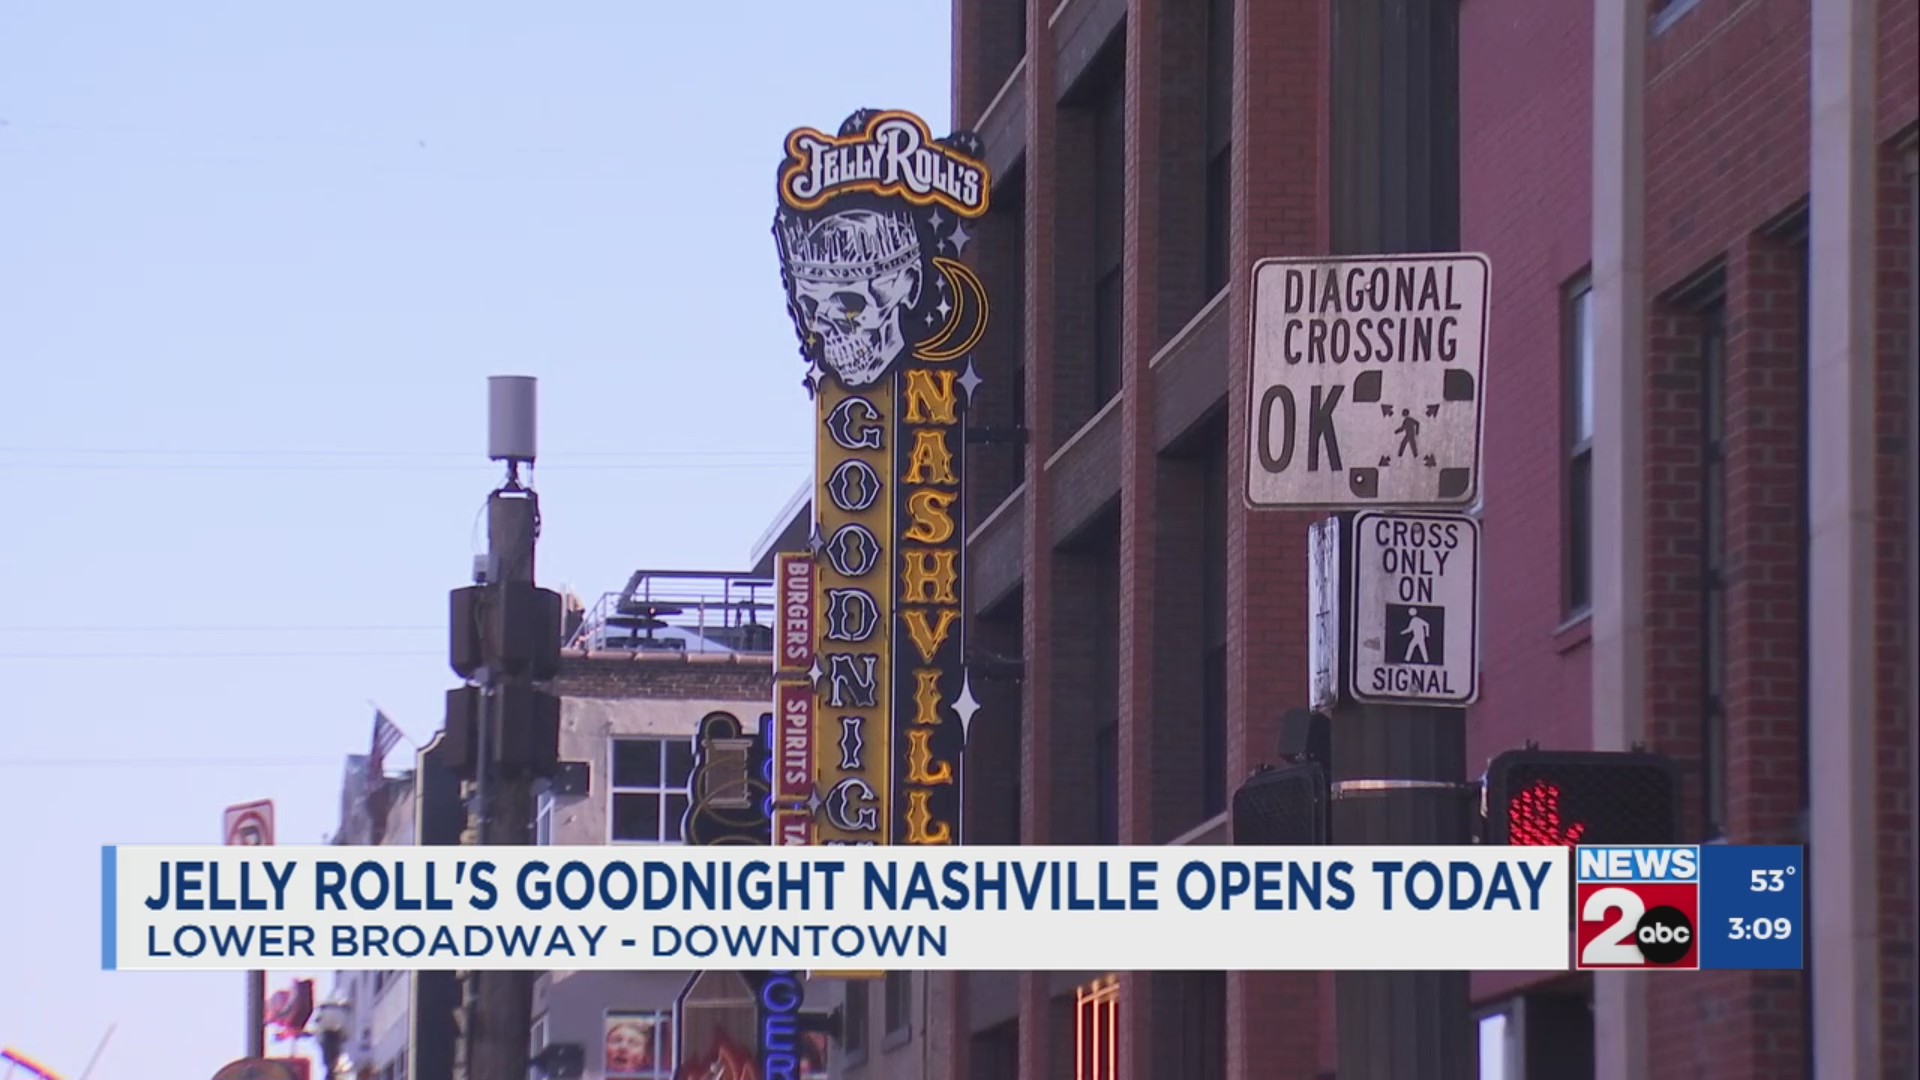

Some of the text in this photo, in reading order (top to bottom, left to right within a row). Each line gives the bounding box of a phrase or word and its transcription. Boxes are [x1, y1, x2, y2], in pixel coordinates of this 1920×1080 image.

[792, 119, 979, 206] JELLY ROLL'S
[1284, 266, 1462, 314] DIAGONAL
[1284, 316, 1458, 365] CROSSING
[1257, 384, 1345, 474] OK
[1375, 519, 1459, 550] CROSS
[1382, 547, 1450, 577] ONLY
[786, 562, 809, 660] BURGERS
[1399, 576, 1434, 603] ON
[826, 397, 884, 846] GOODNIG
[1372, 666, 1456, 695] SIGNAL
[786, 699, 809, 785] SPIRITS
